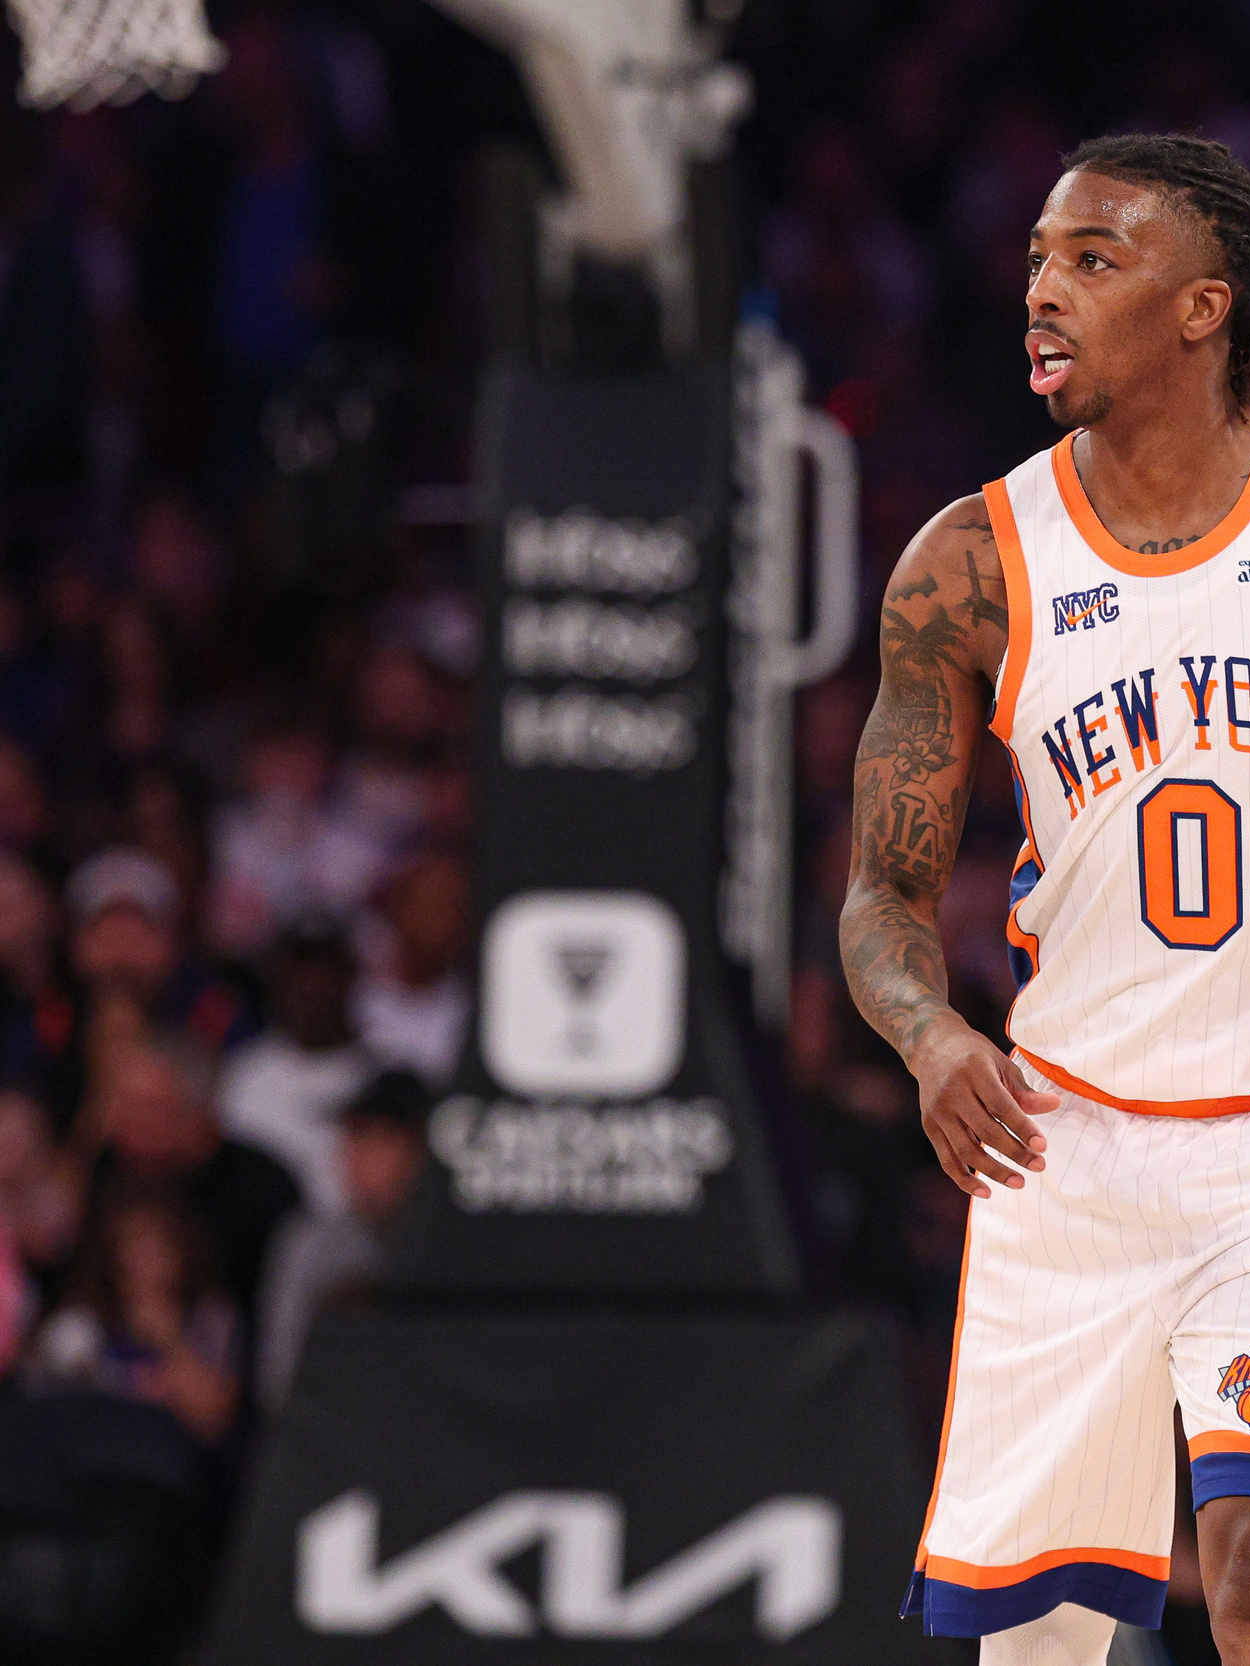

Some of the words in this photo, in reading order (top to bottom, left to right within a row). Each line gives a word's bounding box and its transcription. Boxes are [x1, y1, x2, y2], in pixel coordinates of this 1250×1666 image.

[1053, 582, 1120, 635] NYC
[1042, 668, 1165, 820] NEW
[1136, 777, 1244, 952] 0
